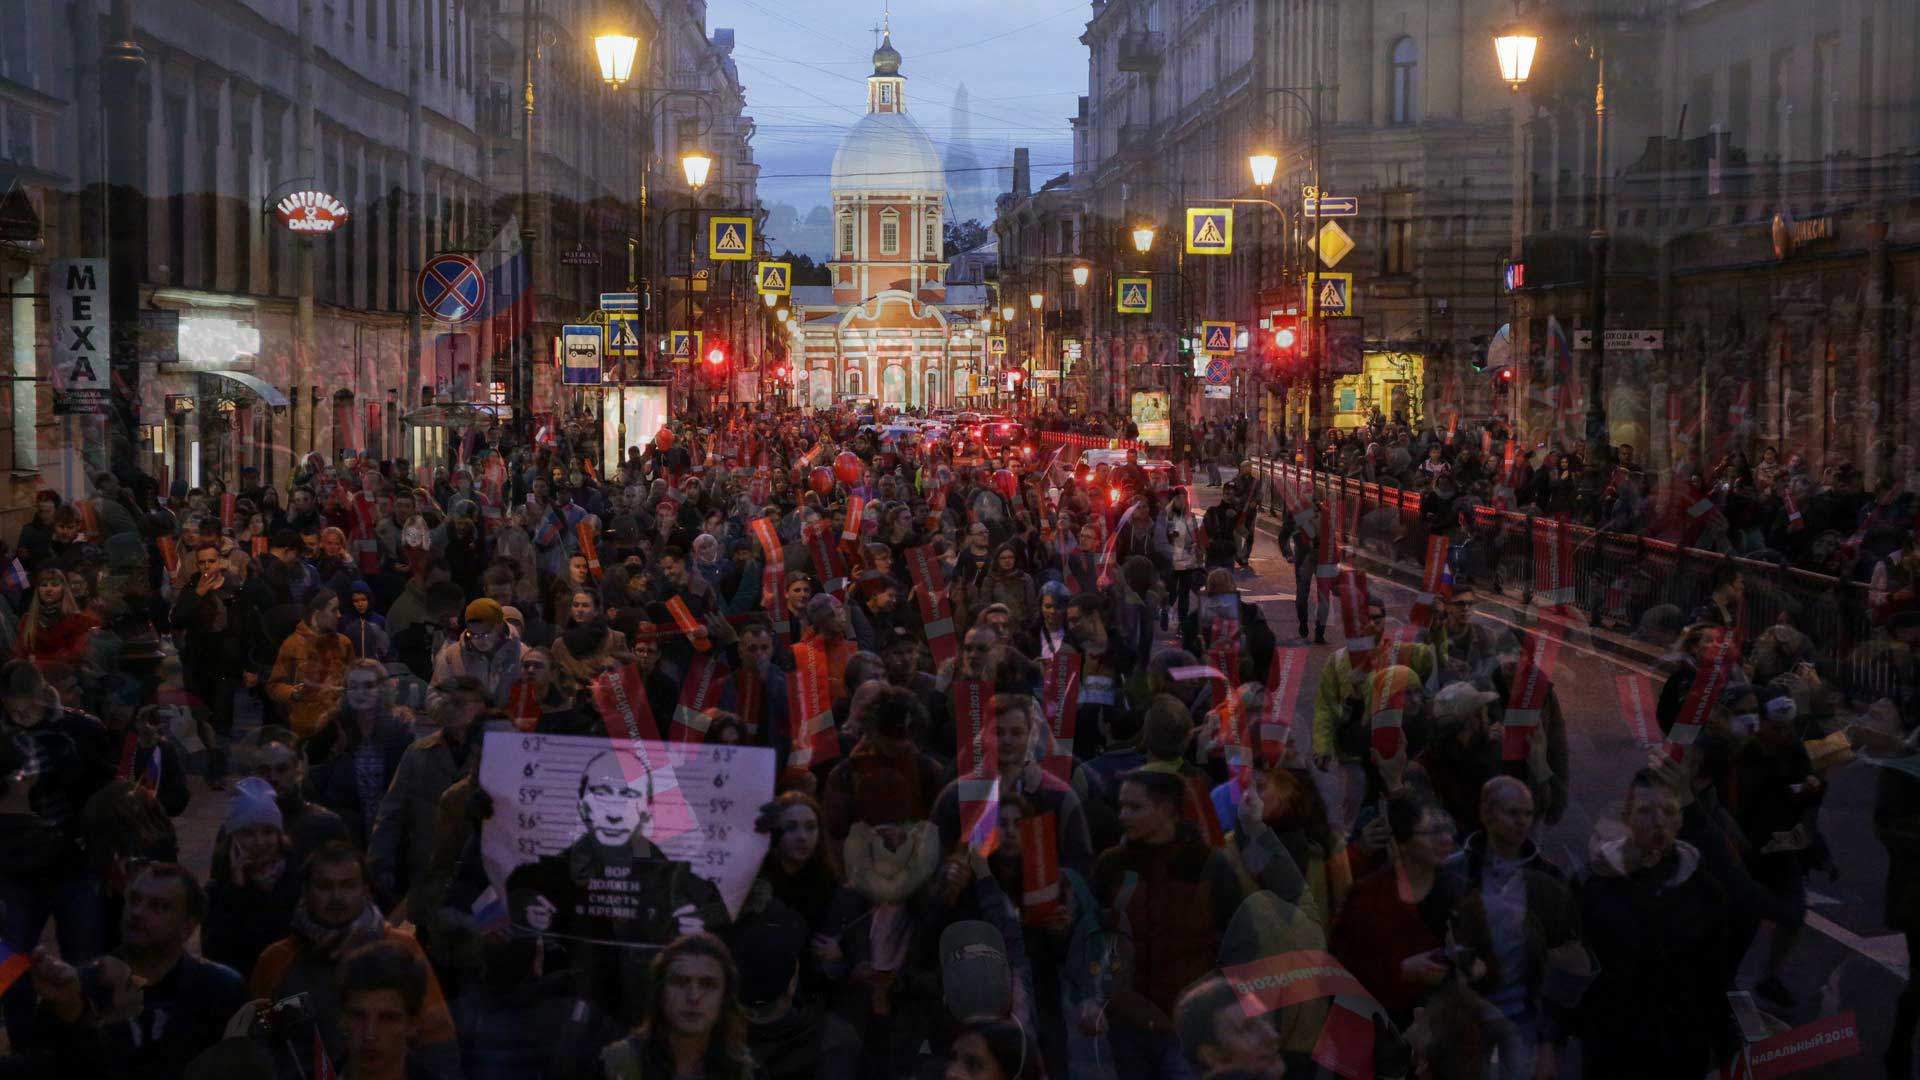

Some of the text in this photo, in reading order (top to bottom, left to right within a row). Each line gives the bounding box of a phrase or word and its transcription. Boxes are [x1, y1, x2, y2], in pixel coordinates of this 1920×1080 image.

[289, 219, 335, 230] DANDY
[66, 265, 97, 382] МЕХА
[604, 865, 632, 878] ВОР
[587, 879, 640, 892] ДОЛЖЕН
